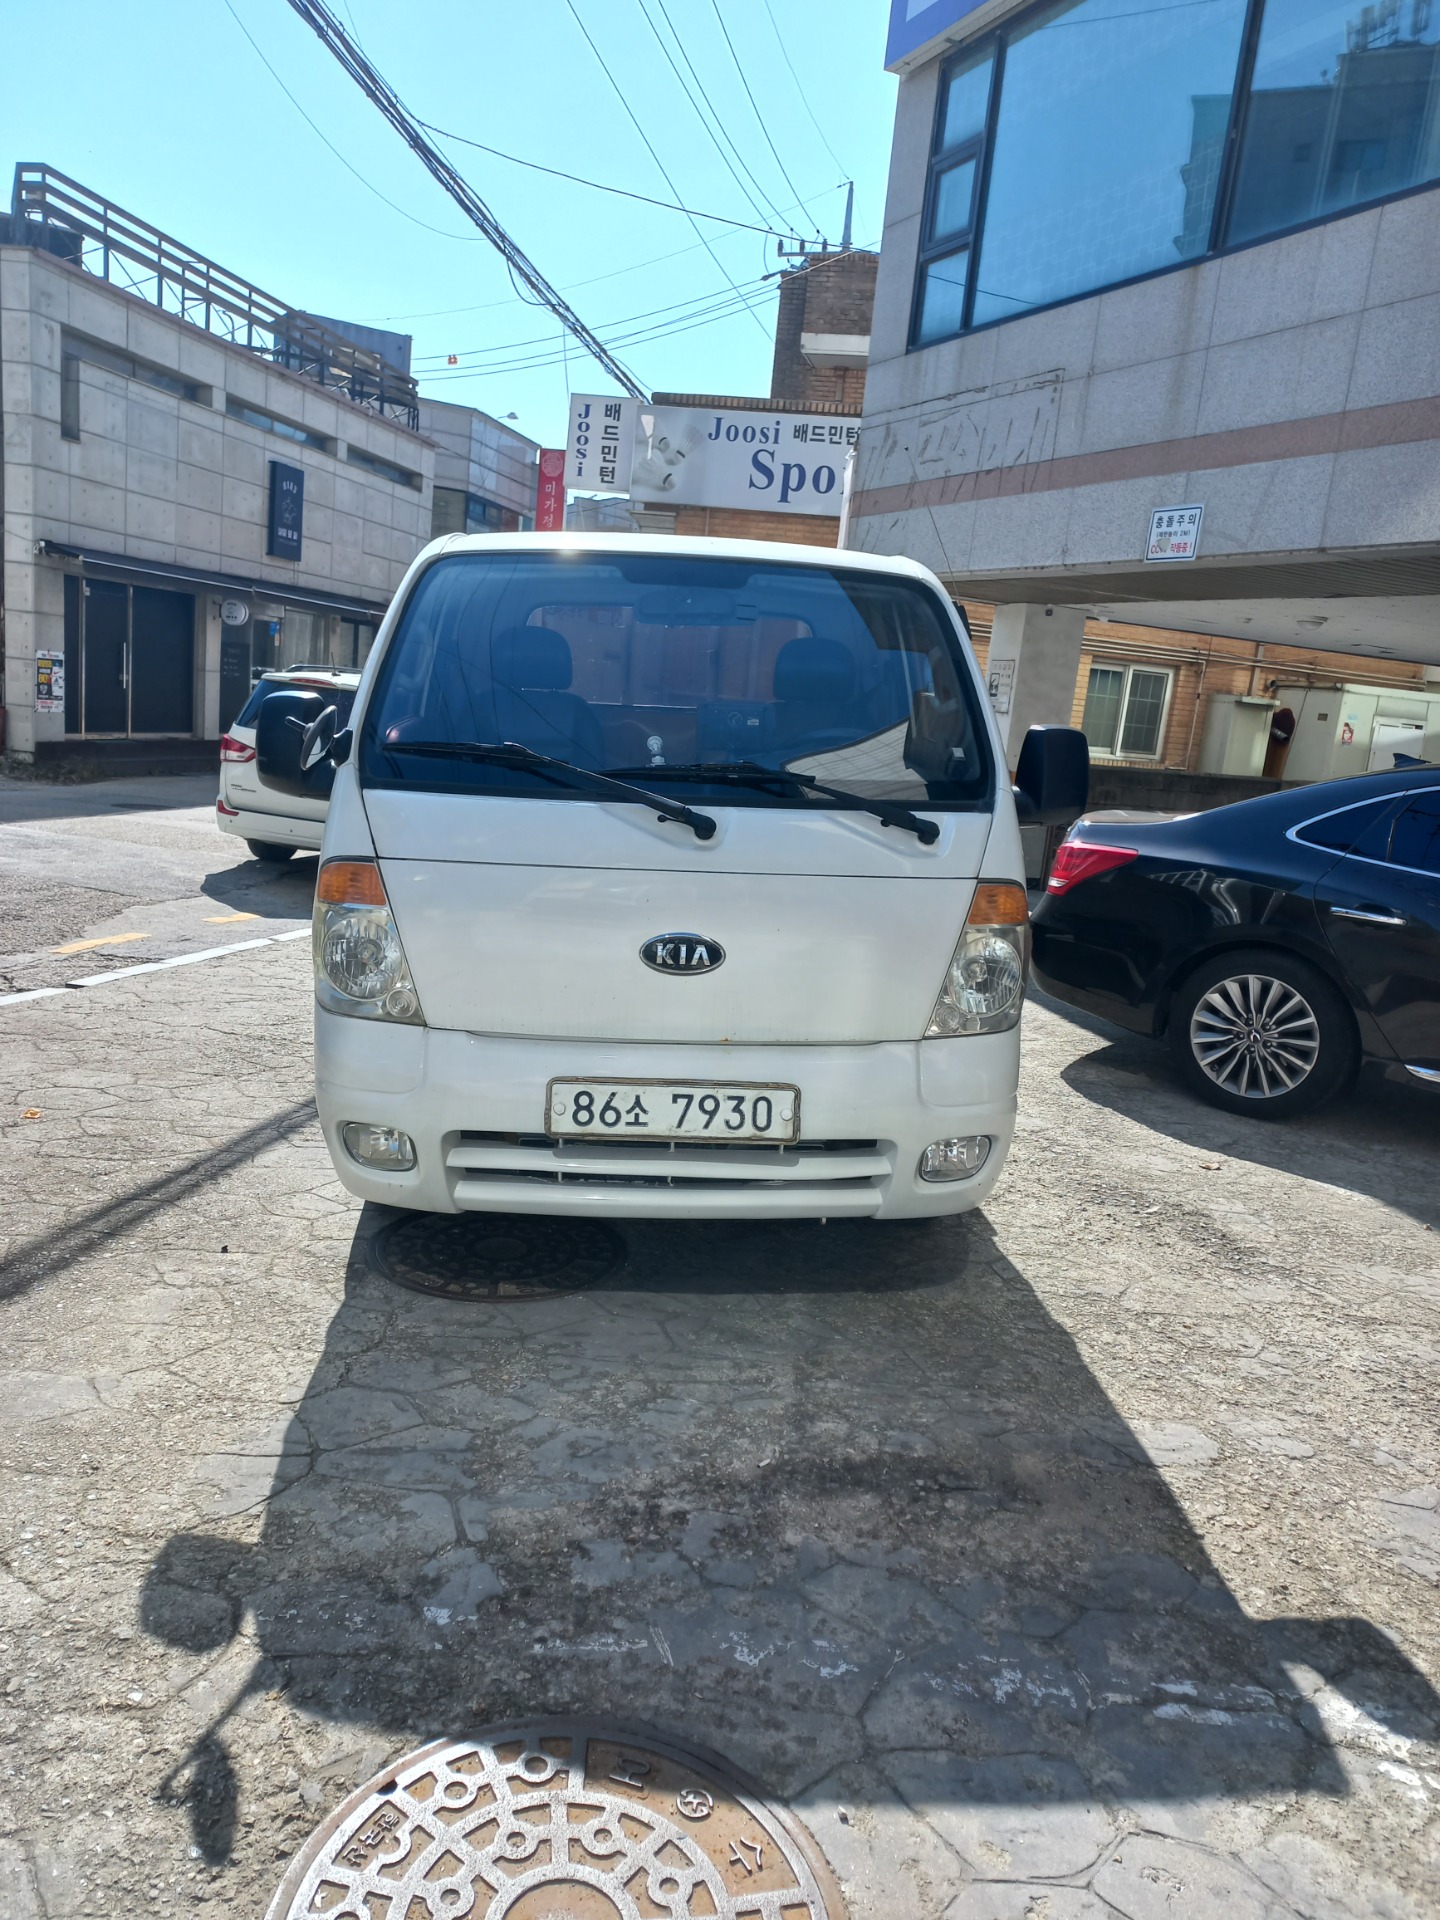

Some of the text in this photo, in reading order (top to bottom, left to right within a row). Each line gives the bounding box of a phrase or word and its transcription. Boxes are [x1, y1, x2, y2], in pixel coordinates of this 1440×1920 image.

[575, 404, 592, 476] Joosi
[600, 404, 621, 484] 배드민턴
[708, 417, 780, 444] Joosi
[749, 449, 843, 503] Spo
[656, 943, 711, 966] KIA
[572, 1090, 773, 1132] 86소 7930
